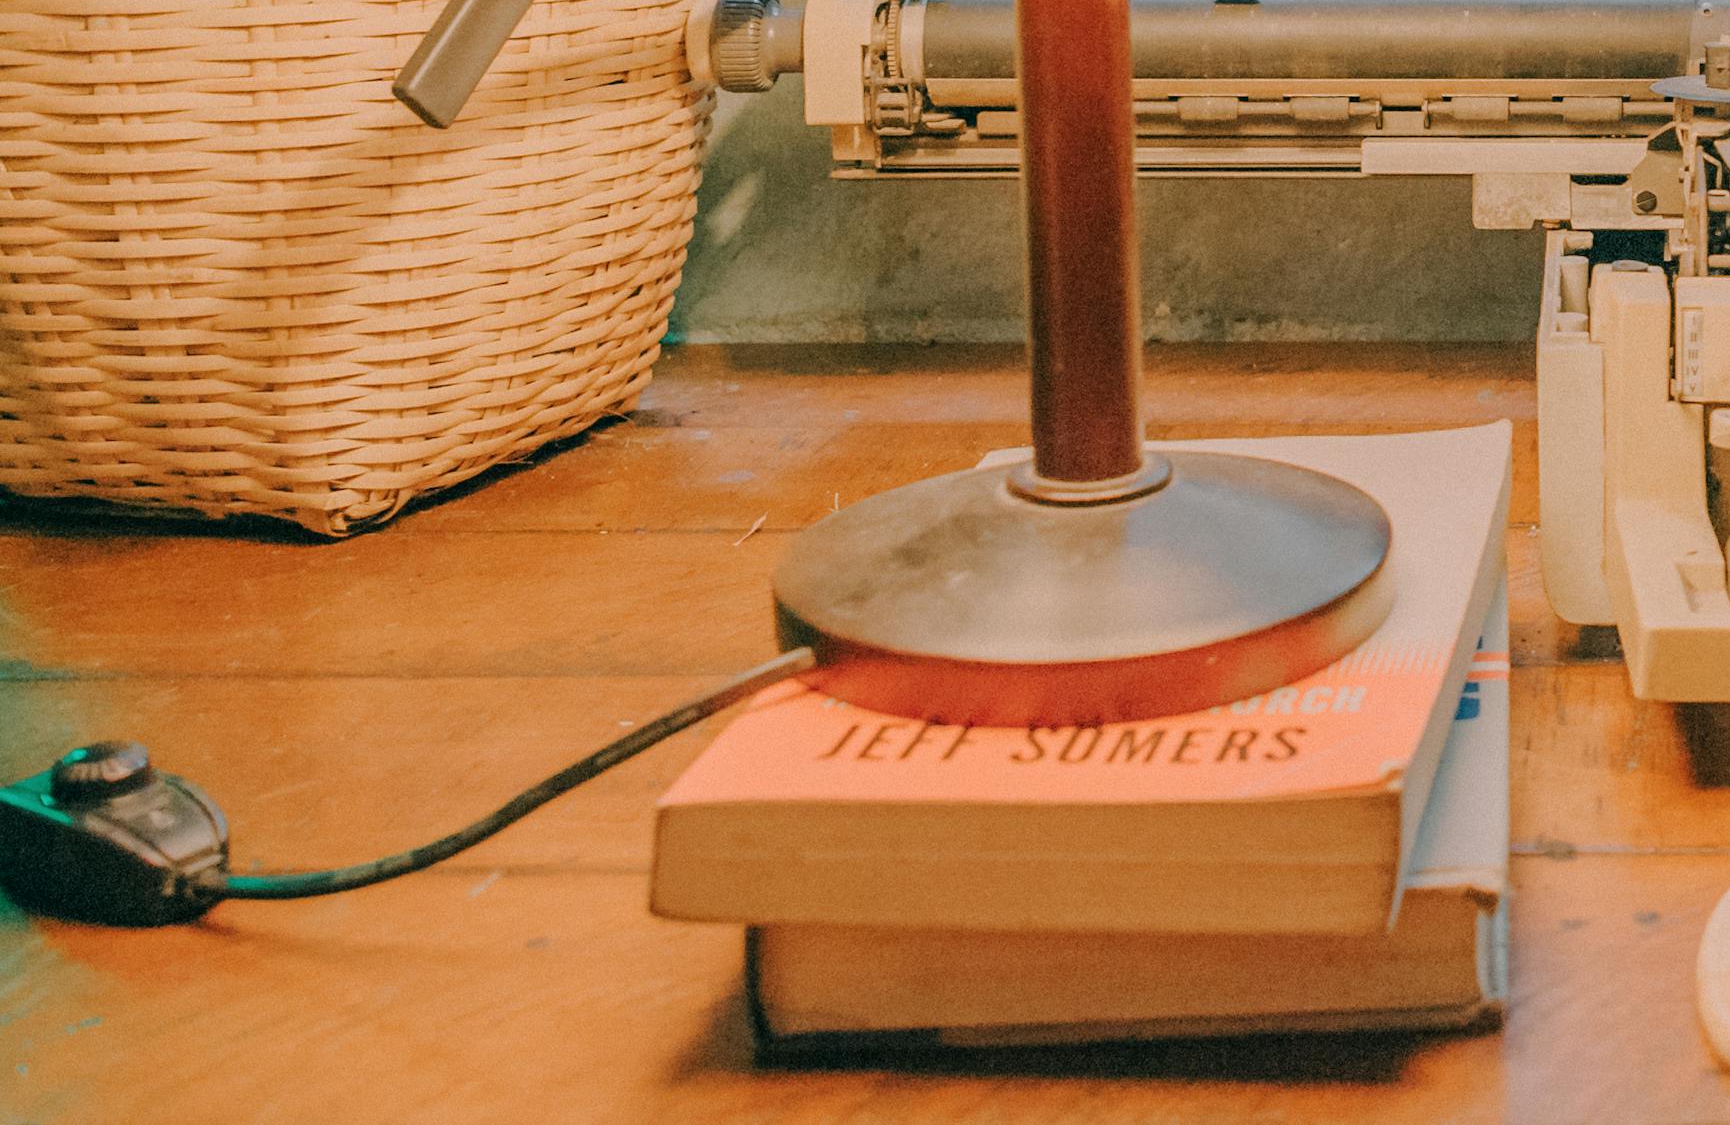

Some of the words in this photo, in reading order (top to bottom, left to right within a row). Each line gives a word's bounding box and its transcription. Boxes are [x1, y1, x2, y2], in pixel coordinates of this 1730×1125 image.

[1209, 685, 1367, 716] URCH
[818, 722, 978, 764] JEFF
[1008, 724, 1308, 764] SOMERS
